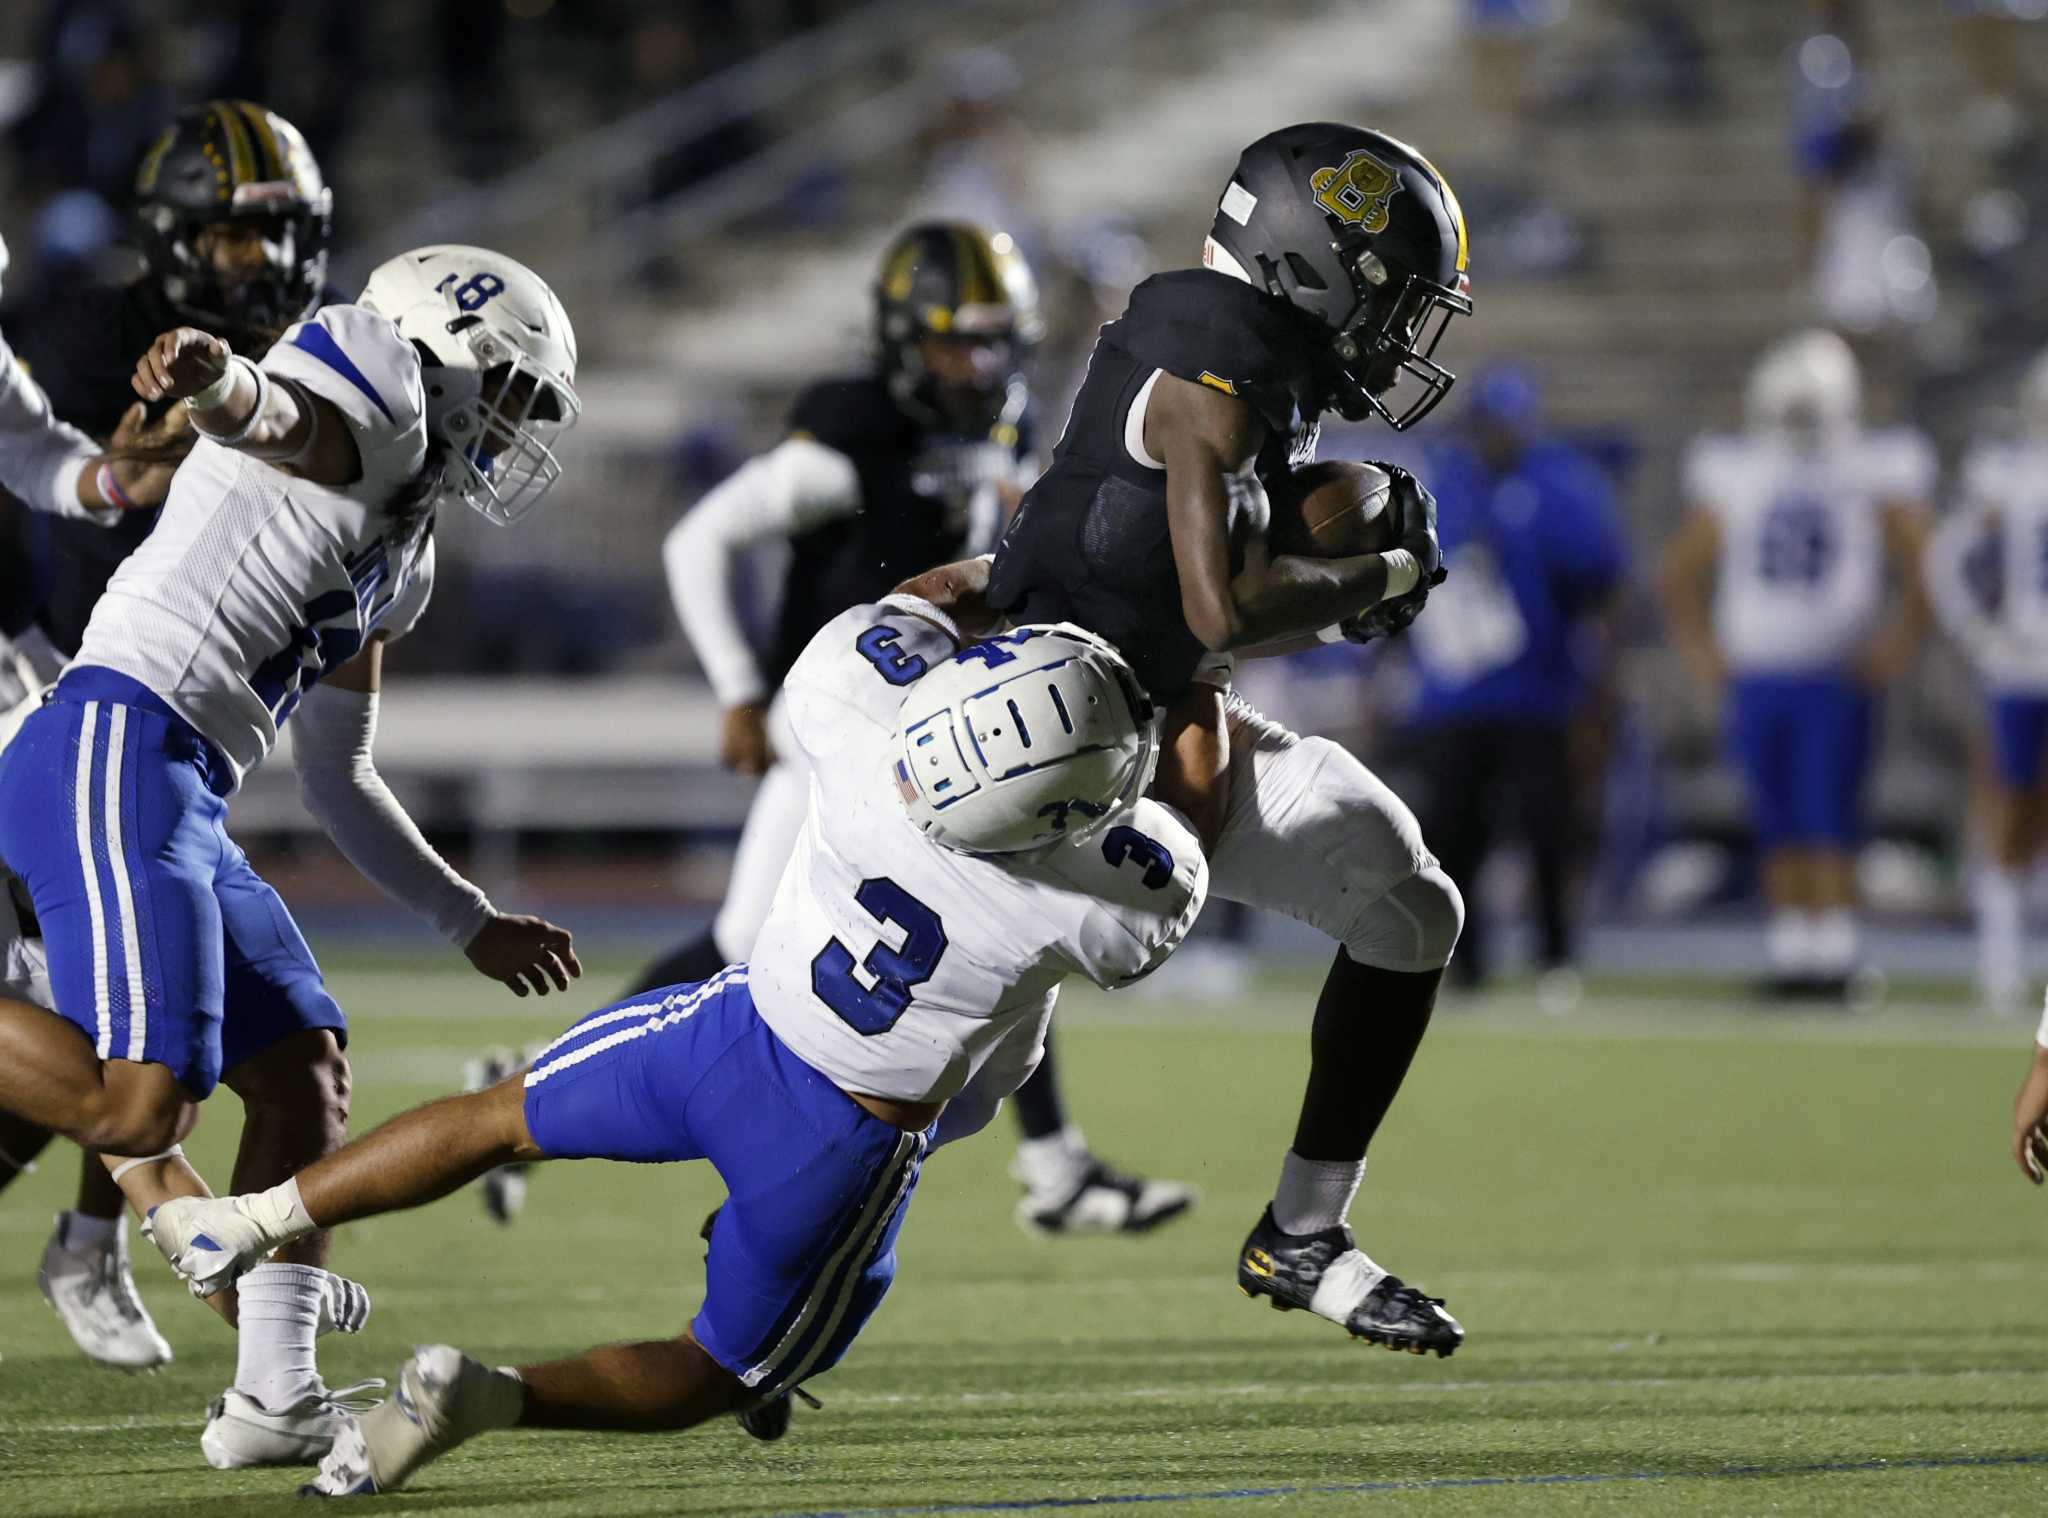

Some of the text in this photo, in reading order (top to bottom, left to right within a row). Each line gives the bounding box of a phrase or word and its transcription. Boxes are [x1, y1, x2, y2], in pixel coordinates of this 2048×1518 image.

[856, 624, 928, 687] 3
[1101, 824, 1175, 890] 3
[811, 876, 949, 1036] 3
